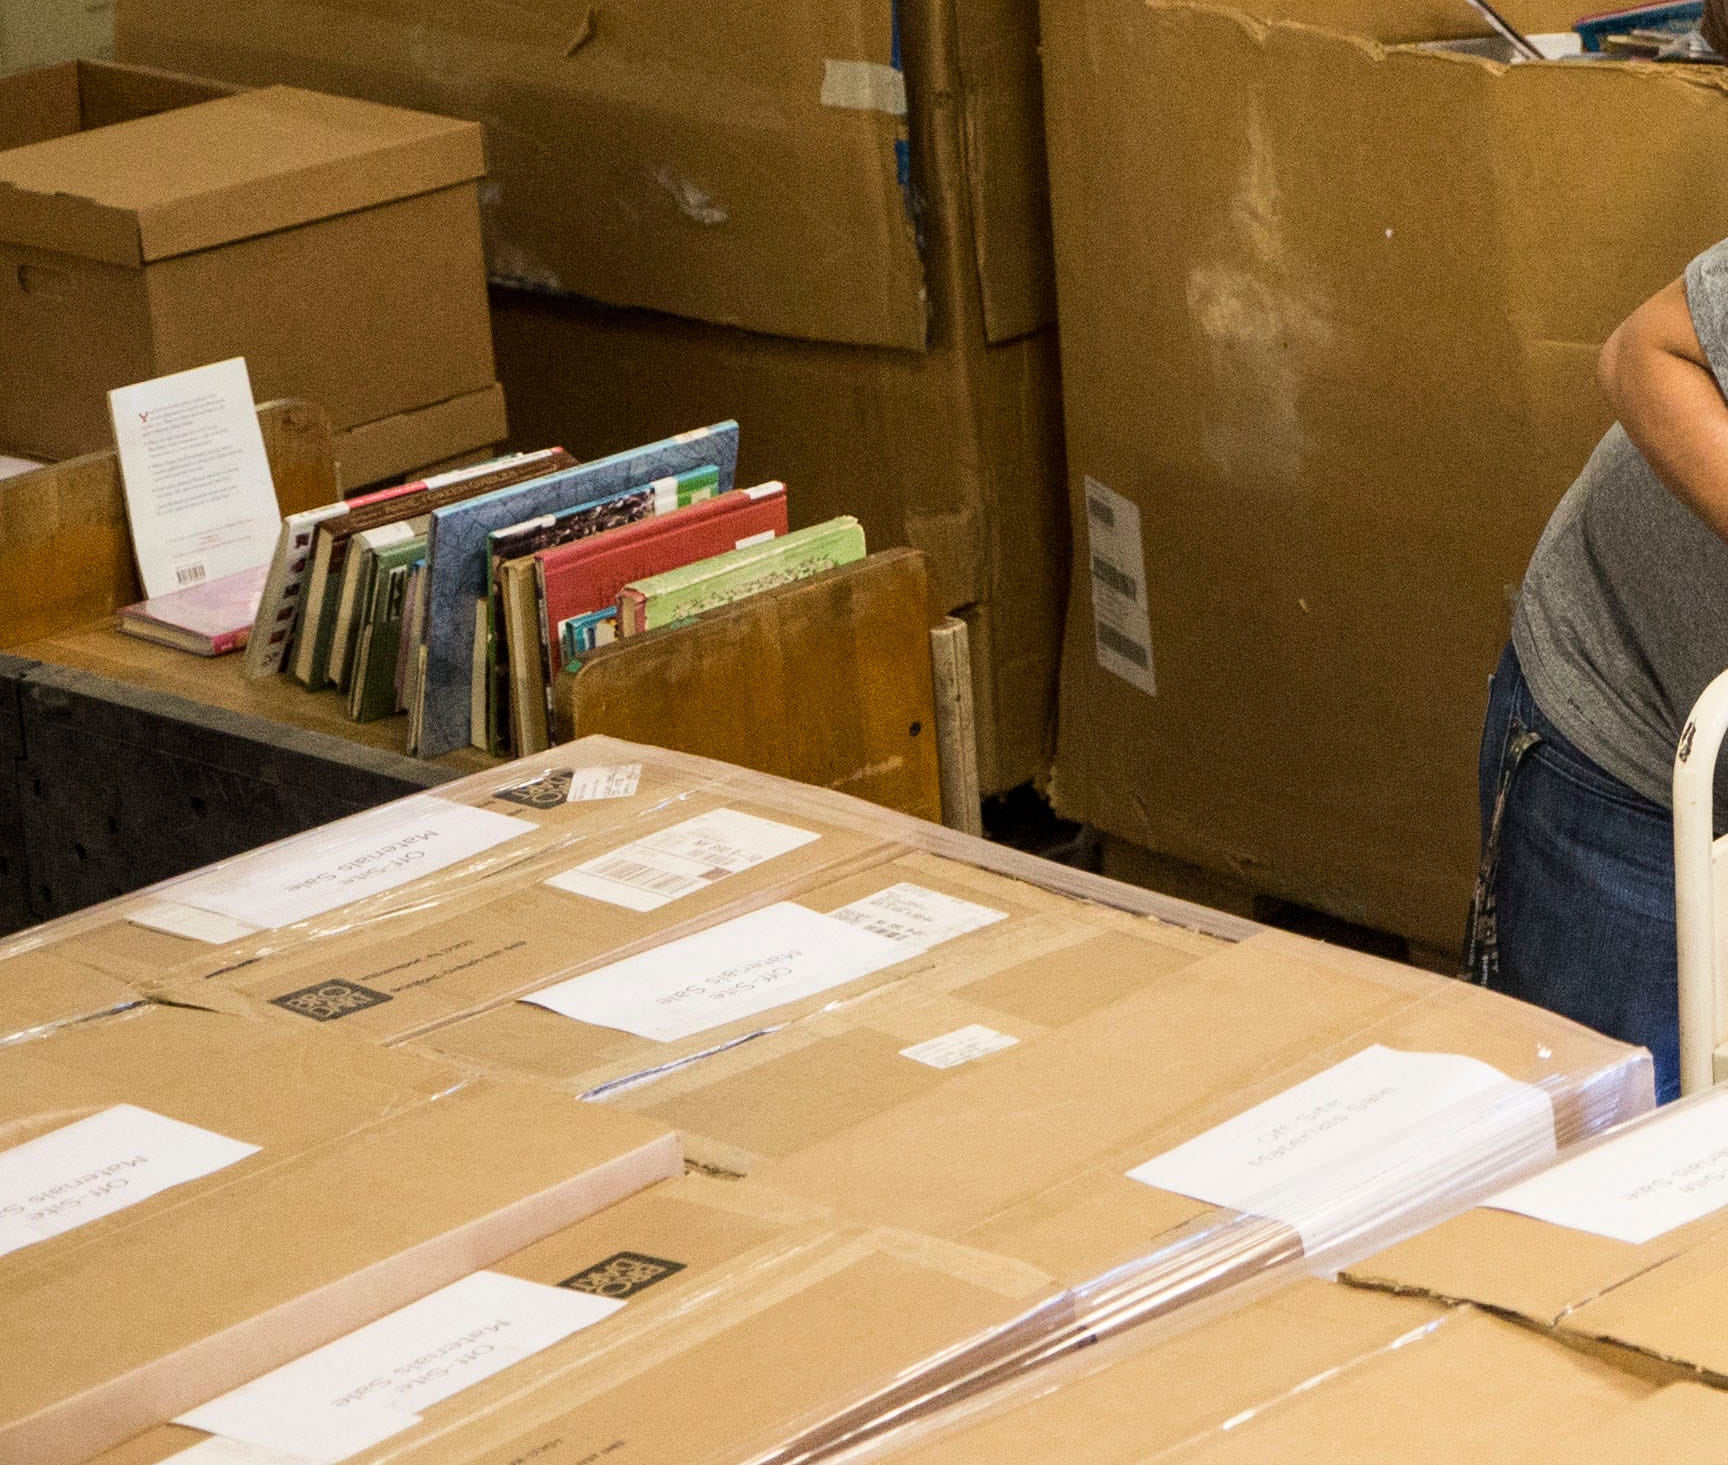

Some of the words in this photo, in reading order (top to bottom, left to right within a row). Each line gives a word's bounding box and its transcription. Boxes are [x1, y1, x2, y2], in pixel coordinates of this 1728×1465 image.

[338, 830, 439, 872] Materials
[286, 872, 337, 892] Sale
[704, 949, 804, 985] Materials
[708, 965, 794, 1001] Off-Site
[655, 985, 707, 1006] Sale
[1246, 1113, 1351, 1167] Materials
[24, 1177, 129, 1221] Off-Site
[27, 1154, 149, 1203] Materials
[393, 1320, 513, 1375] Materials
[394, 1344, 495, 1394] Off-Site
[332, 1378, 393, 1409] Sale
